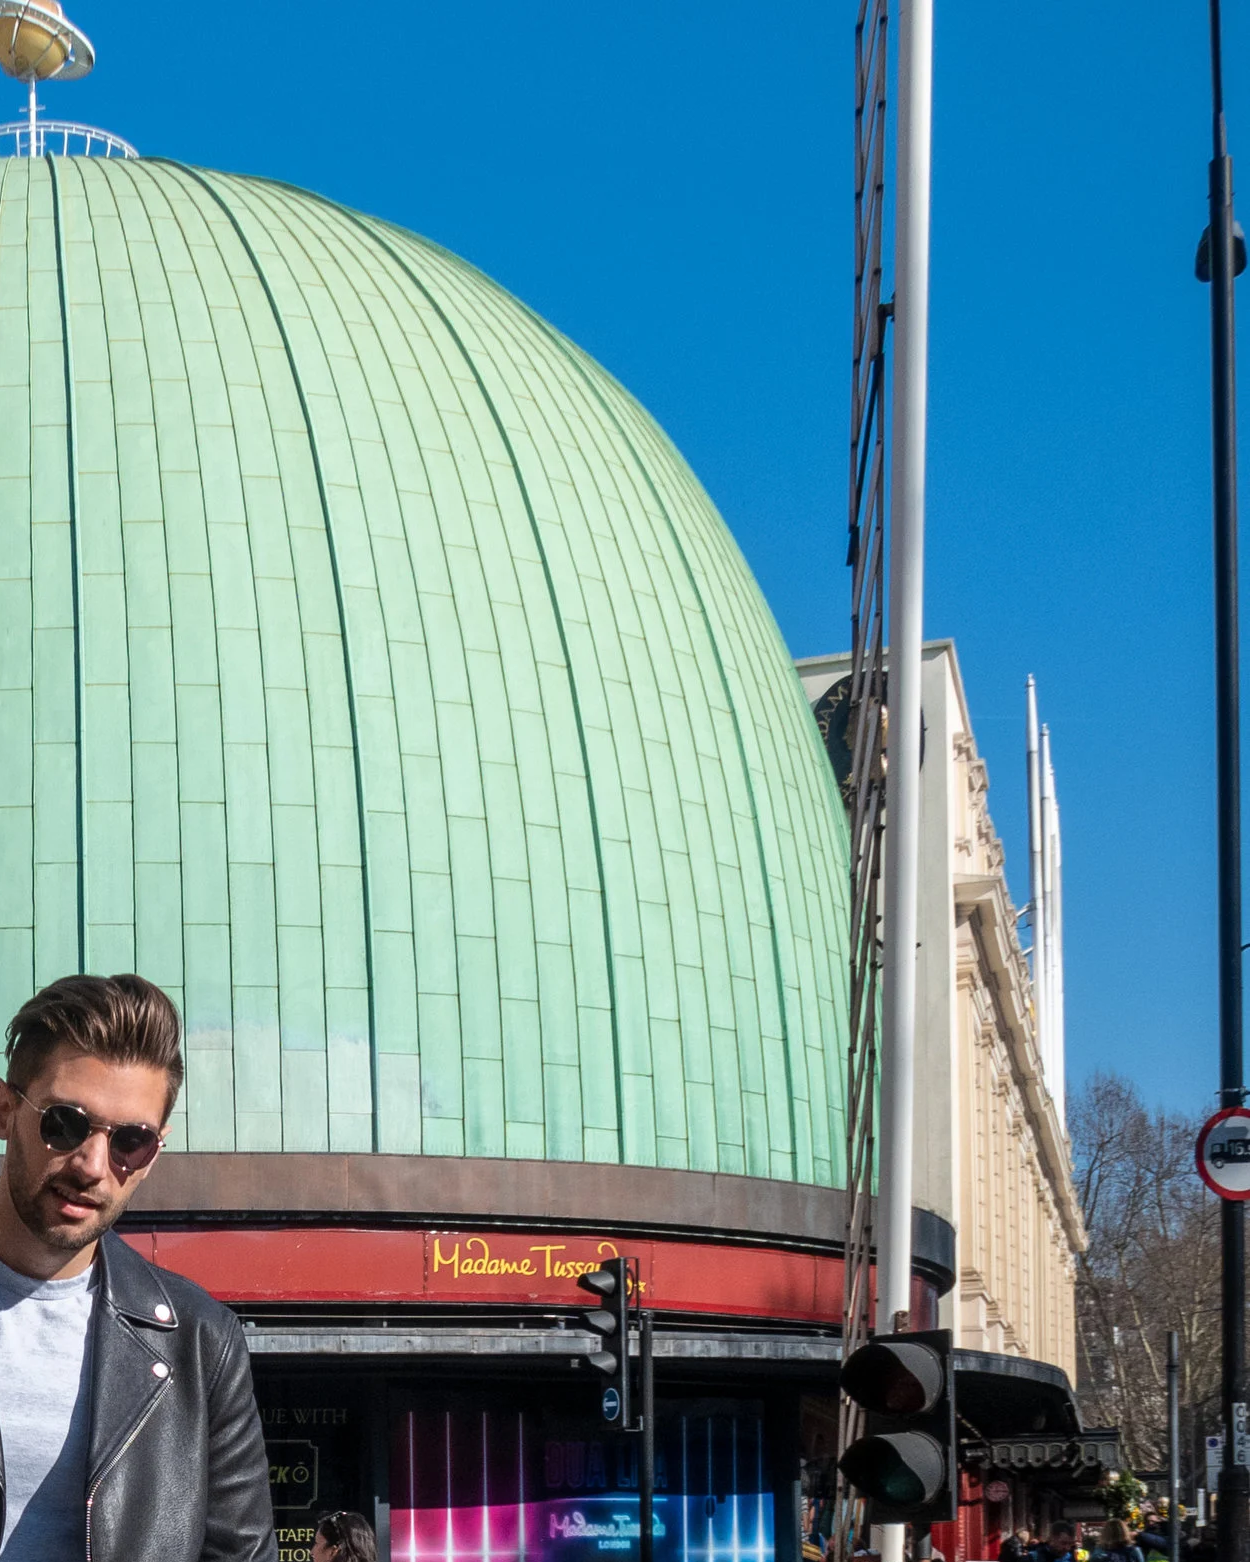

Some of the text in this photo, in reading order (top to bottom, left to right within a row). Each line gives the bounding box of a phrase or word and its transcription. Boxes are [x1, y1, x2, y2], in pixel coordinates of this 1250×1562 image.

[433, 1237, 633, 1295] Madame Tussa
[291, 1407, 348, 1425] WITH
[616, 1441, 669, 1488] LIA
[276, 1528, 315, 1542] TAFF
